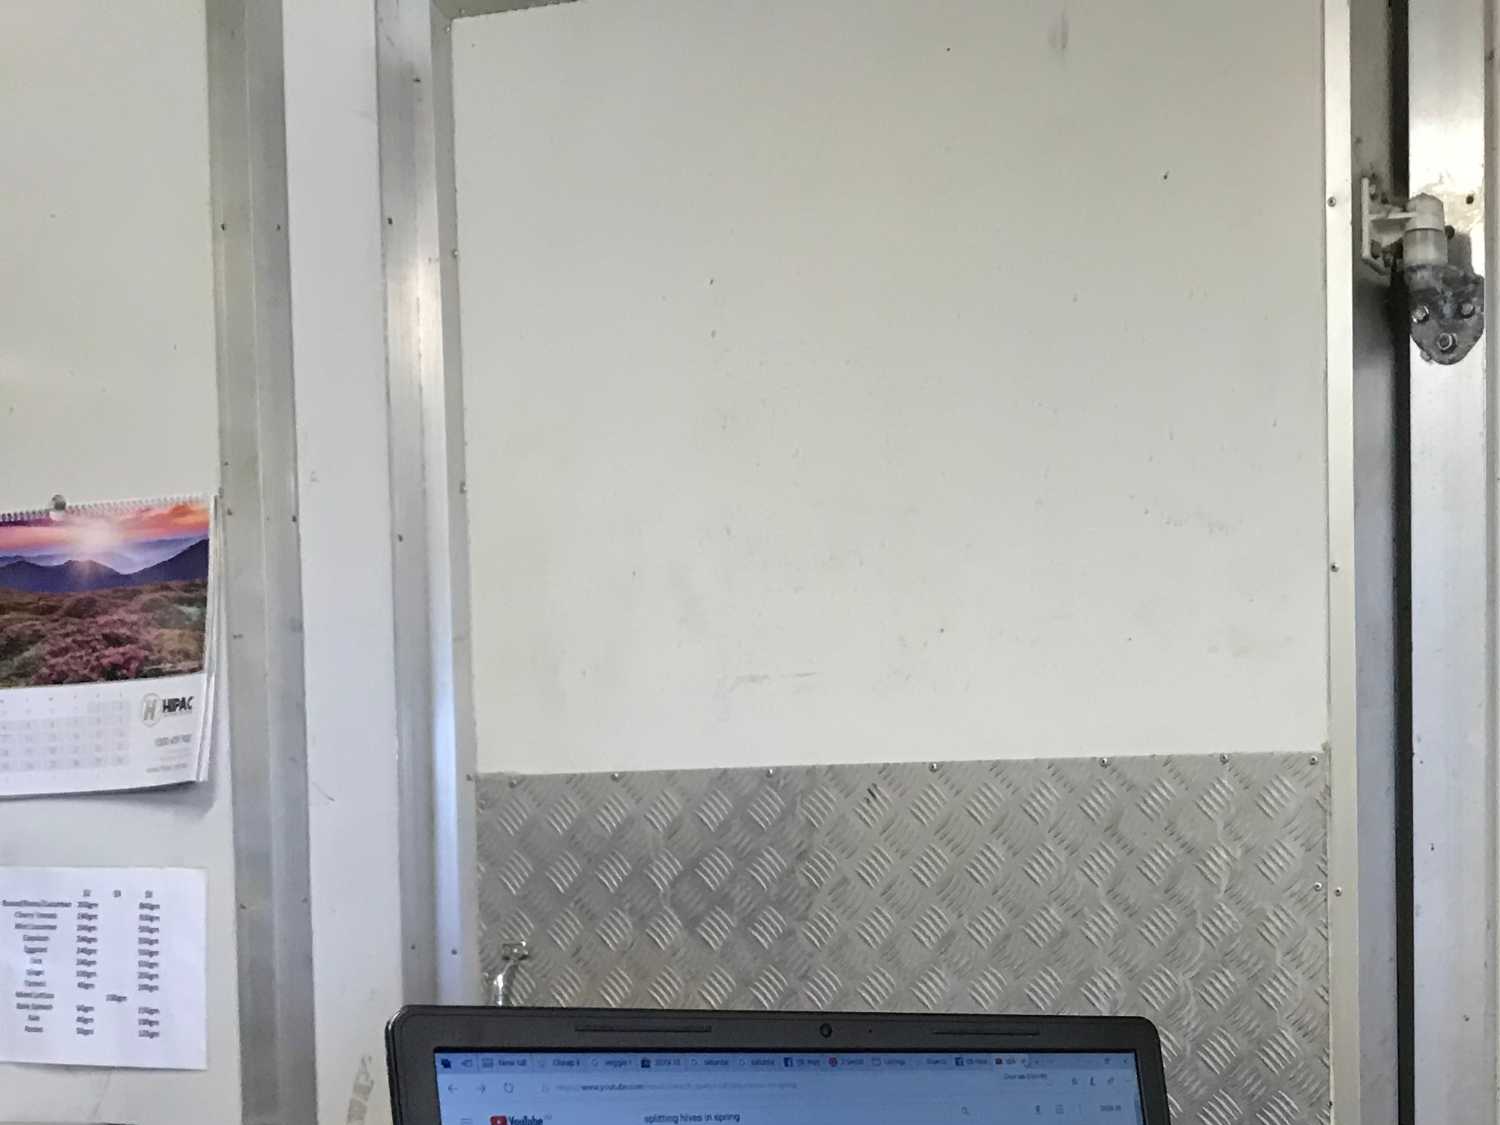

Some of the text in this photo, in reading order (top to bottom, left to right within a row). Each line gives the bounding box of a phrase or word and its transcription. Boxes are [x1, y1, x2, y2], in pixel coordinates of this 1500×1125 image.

[644, 1112, 741, 1125] splitting hives in spring
